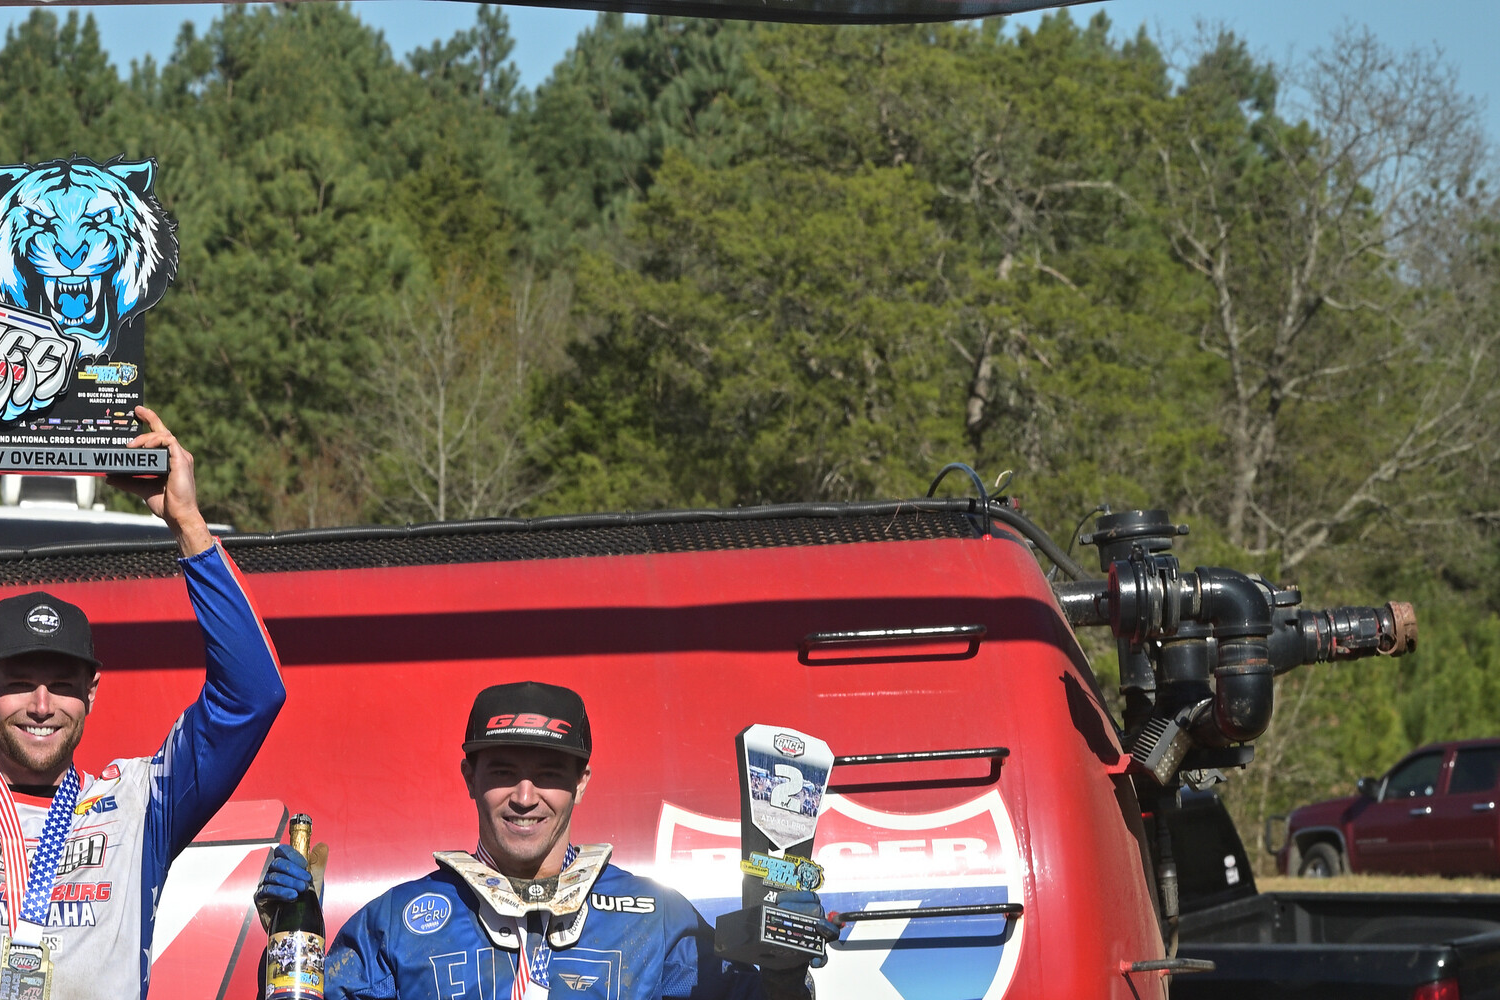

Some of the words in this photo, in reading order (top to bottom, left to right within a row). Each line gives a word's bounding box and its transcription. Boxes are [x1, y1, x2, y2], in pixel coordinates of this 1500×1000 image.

[11, 435, 48, 444] NATIONAL
[50, 435, 74, 444] CROSS
[76, 436, 111, 445] COUNTRY
[10, 451, 88, 466] OVERALL
[93, 452, 159, 467] WINNER
[486, 713, 572, 734] GBC
[776, 736, 803, 751] GNCC
[770, 763, 804, 814] 2
[689, 837, 991, 876] RCER
[591, 893, 656, 914] WPS
